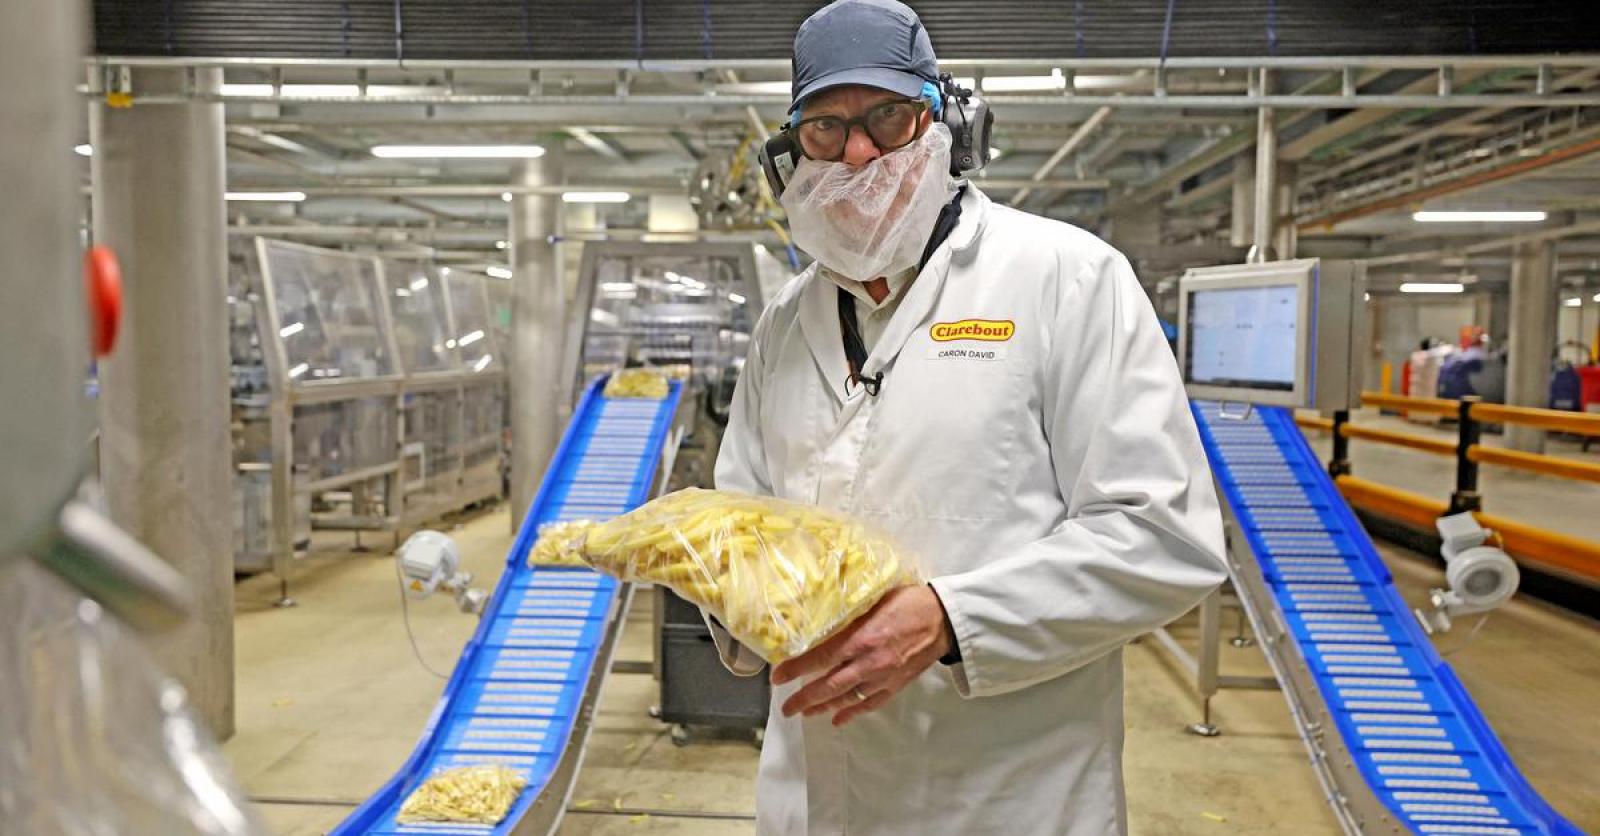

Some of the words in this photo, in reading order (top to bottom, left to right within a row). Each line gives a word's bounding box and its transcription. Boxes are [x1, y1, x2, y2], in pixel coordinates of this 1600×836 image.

[935, 324, 1009, 337] Clarebout
[938, 350, 967, 358] CARON
[968, 351, 995, 359] DAVID
